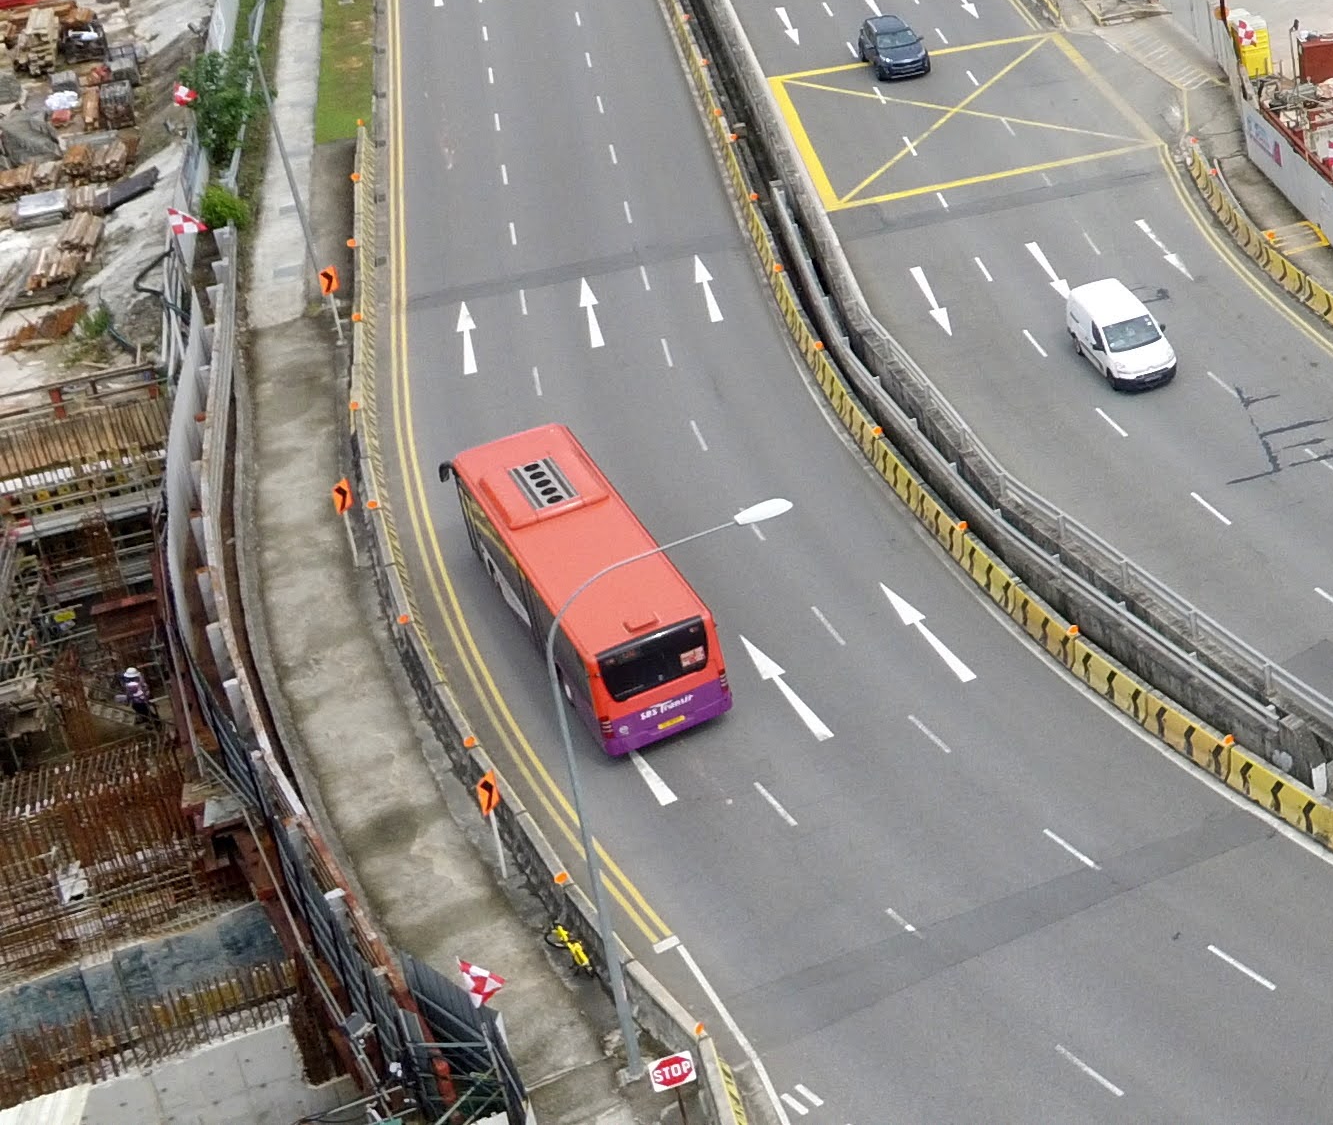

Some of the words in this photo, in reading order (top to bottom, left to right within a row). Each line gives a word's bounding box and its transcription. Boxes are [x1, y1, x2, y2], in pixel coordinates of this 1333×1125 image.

[640, 708, 658, 721] SBS
[649, 693, 694, 714] Transit
[653, 1060, 692, 1083] STOP
